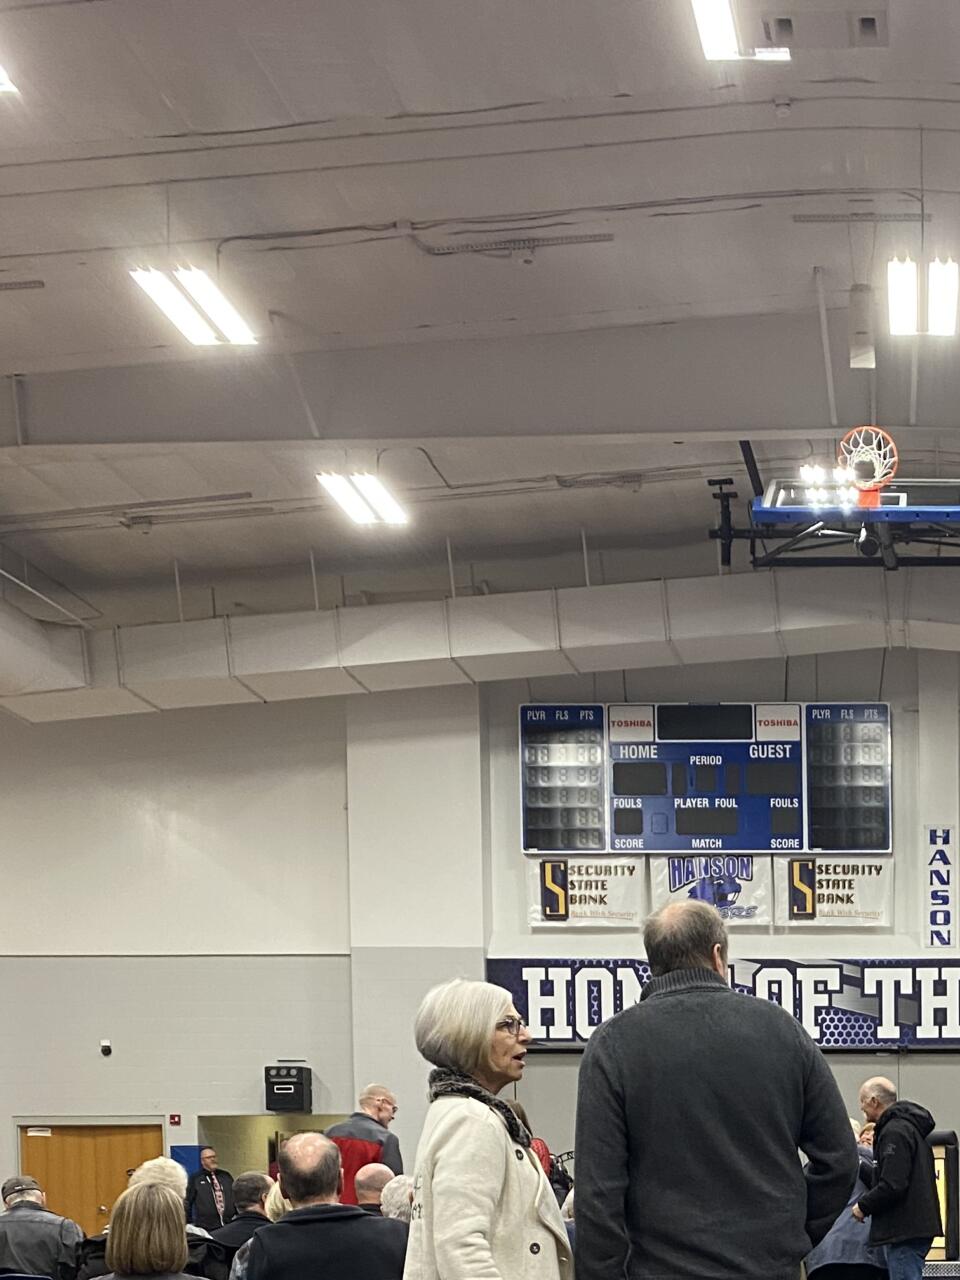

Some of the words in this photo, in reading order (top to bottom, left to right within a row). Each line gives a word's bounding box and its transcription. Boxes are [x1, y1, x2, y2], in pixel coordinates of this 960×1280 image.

[527, 710, 546, 721] PLYR
[555, 710, 569, 721] FLS
[579, 710, 594, 721] PTS
[812, 709, 831, 720] PLYR
[841, 709, 854, 720] FLS
[864, 709, 879, 720] PTS
[611, 720, 653, 728] TOSHIBA
[757, 719, 799, 727] TOSHIBA
[620, 745, 658, 759] HOME
[749, 744, 792, 759] GUEST
[690, 755, 722, 765] PERIOD
[613, 798, 642, 808] FOULS
[674, 798, 709, 808] PLAYER
[715, 798, 738, 808] FOUL
[770, 798, 799, 808] FOULS
[614, 838, 644, 848] SCORE
[691, 838, 722, 848] MATCH
[770, 838, 800, 848] SCORE
[568, 864, 636, 877] SECURITY
[667, 855, 753, 893] HANSON
[816, 864, 883, 876] SECURITY
[569, 879, 608, 891] STATE
[816, 878, 855, 890] STATE
[928, 829, 951, 946] HANSON
[569, 893, 608, 906] BANK
[816, 893, 855, 905] BANK
[755, 966, 840, 1040] OF
